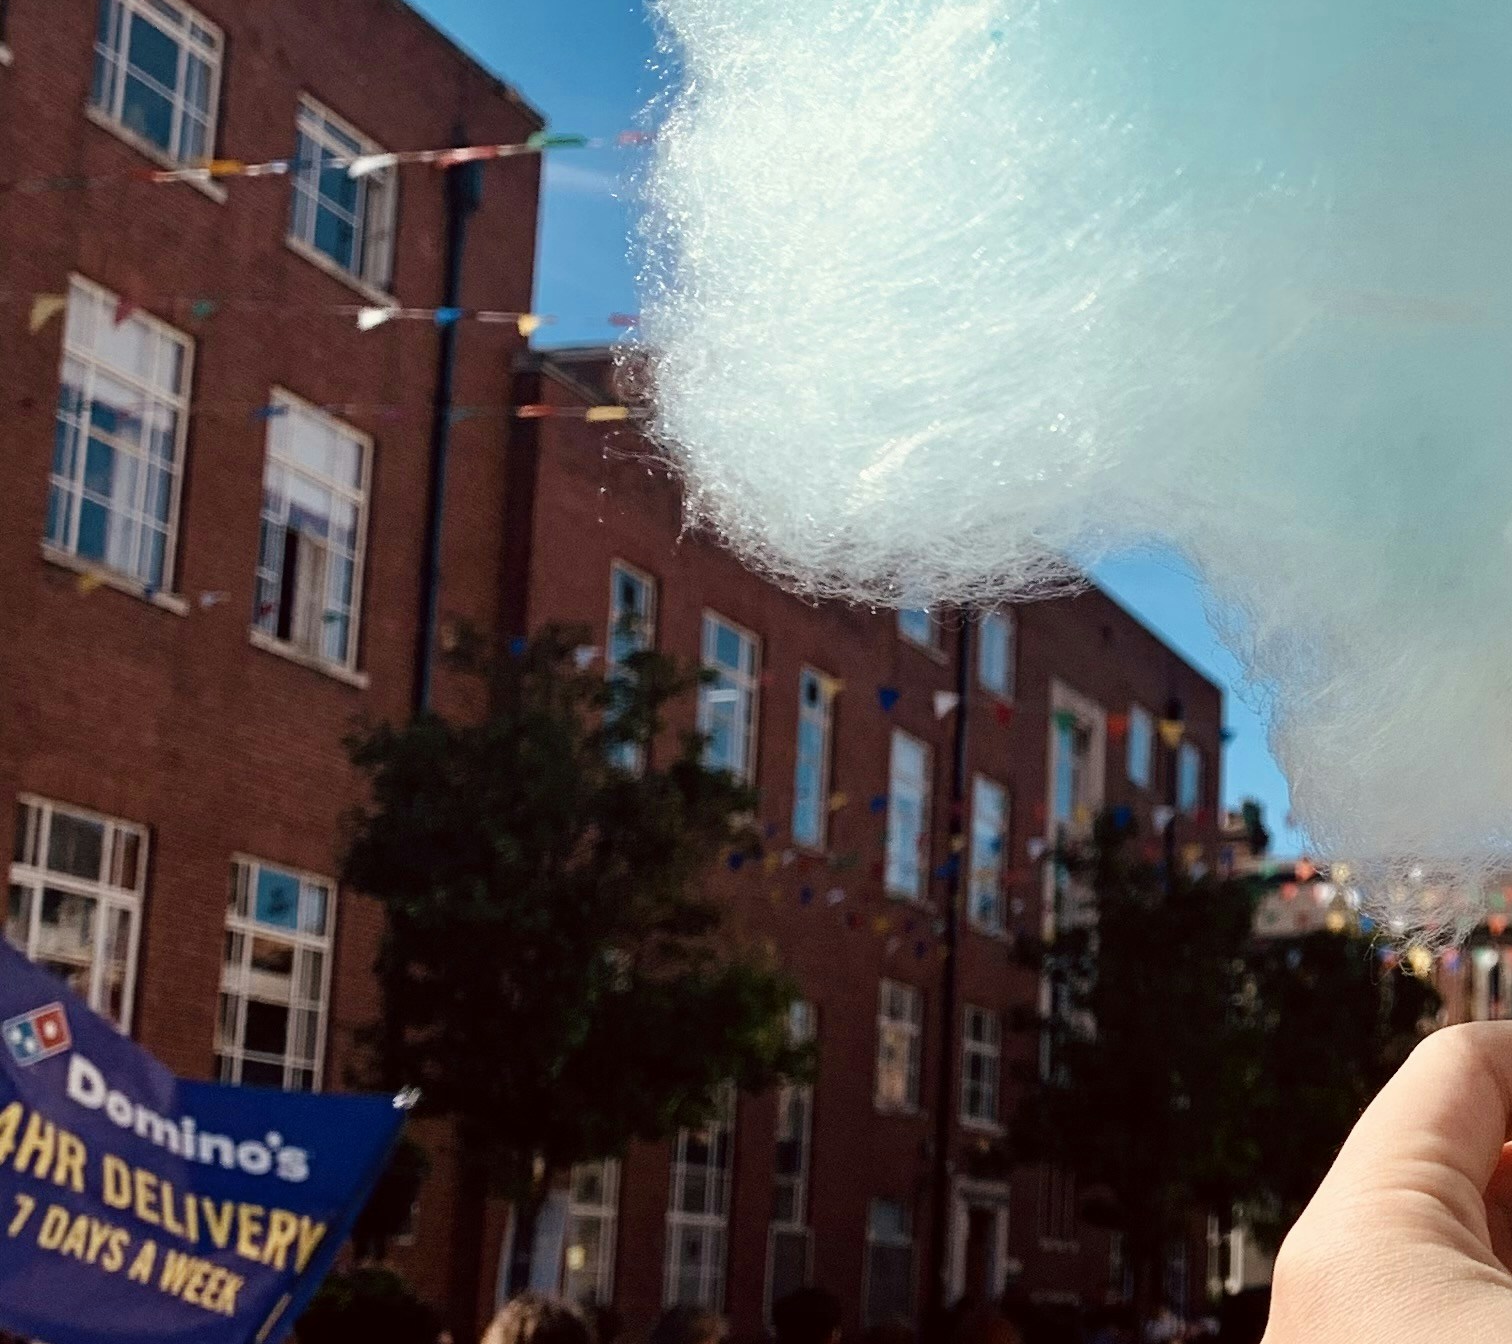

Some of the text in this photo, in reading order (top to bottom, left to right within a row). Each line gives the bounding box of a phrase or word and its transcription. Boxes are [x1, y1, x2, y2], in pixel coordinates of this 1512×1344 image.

[67, 1054, 310, 1183] Domino's
[8, 1194, 245, 1318] 7 DAYS A WEEK
[102, 1154, 327, 1275] DELIVERY
